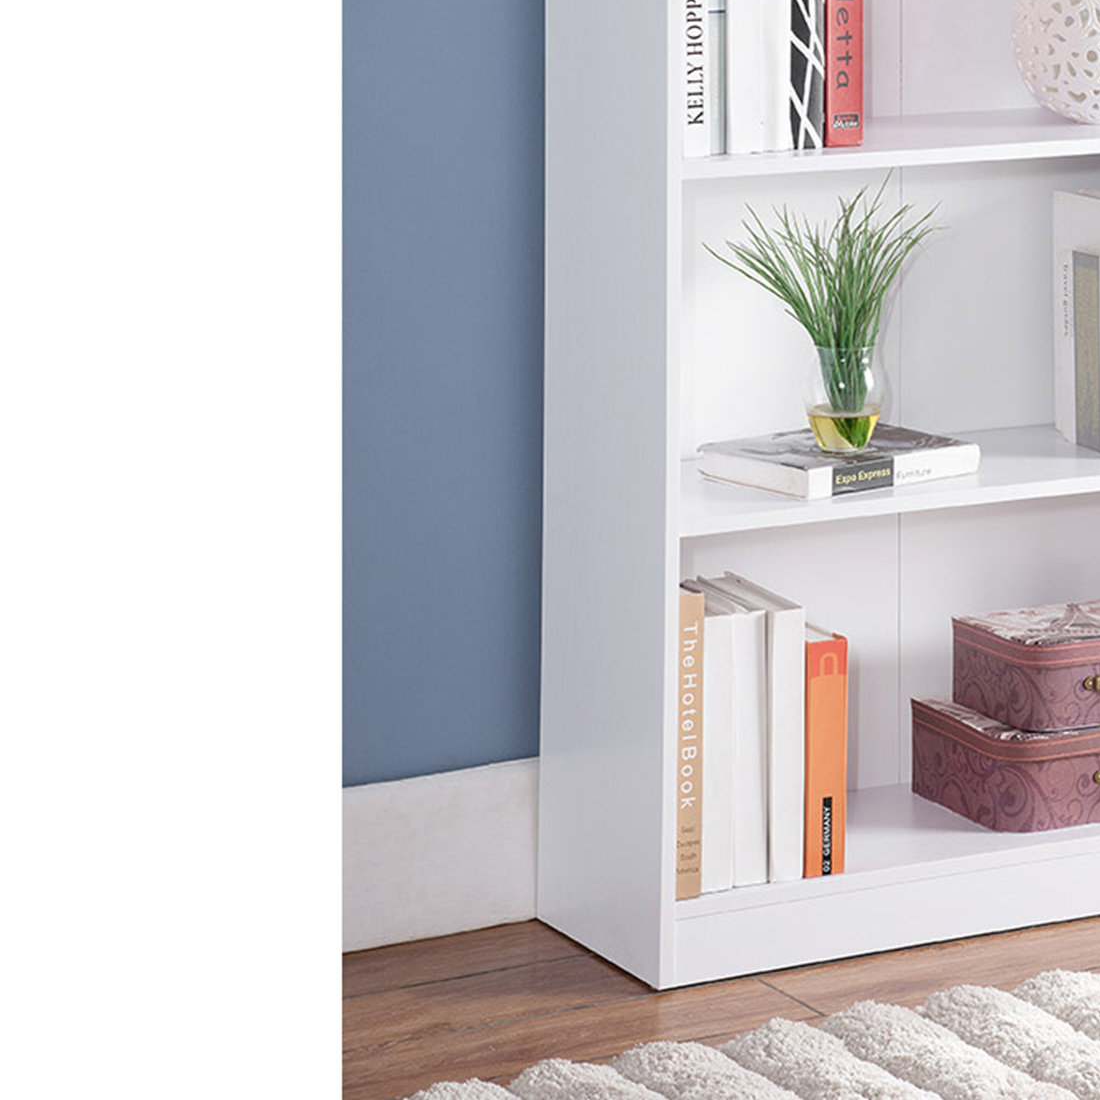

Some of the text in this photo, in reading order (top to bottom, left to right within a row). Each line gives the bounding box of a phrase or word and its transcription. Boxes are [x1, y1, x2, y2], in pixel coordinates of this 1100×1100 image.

[687, 63, 704, 126] KELLY
[835, 467, 891, 485] Expo Express
[822, 805, 832, 857] GERMANY
